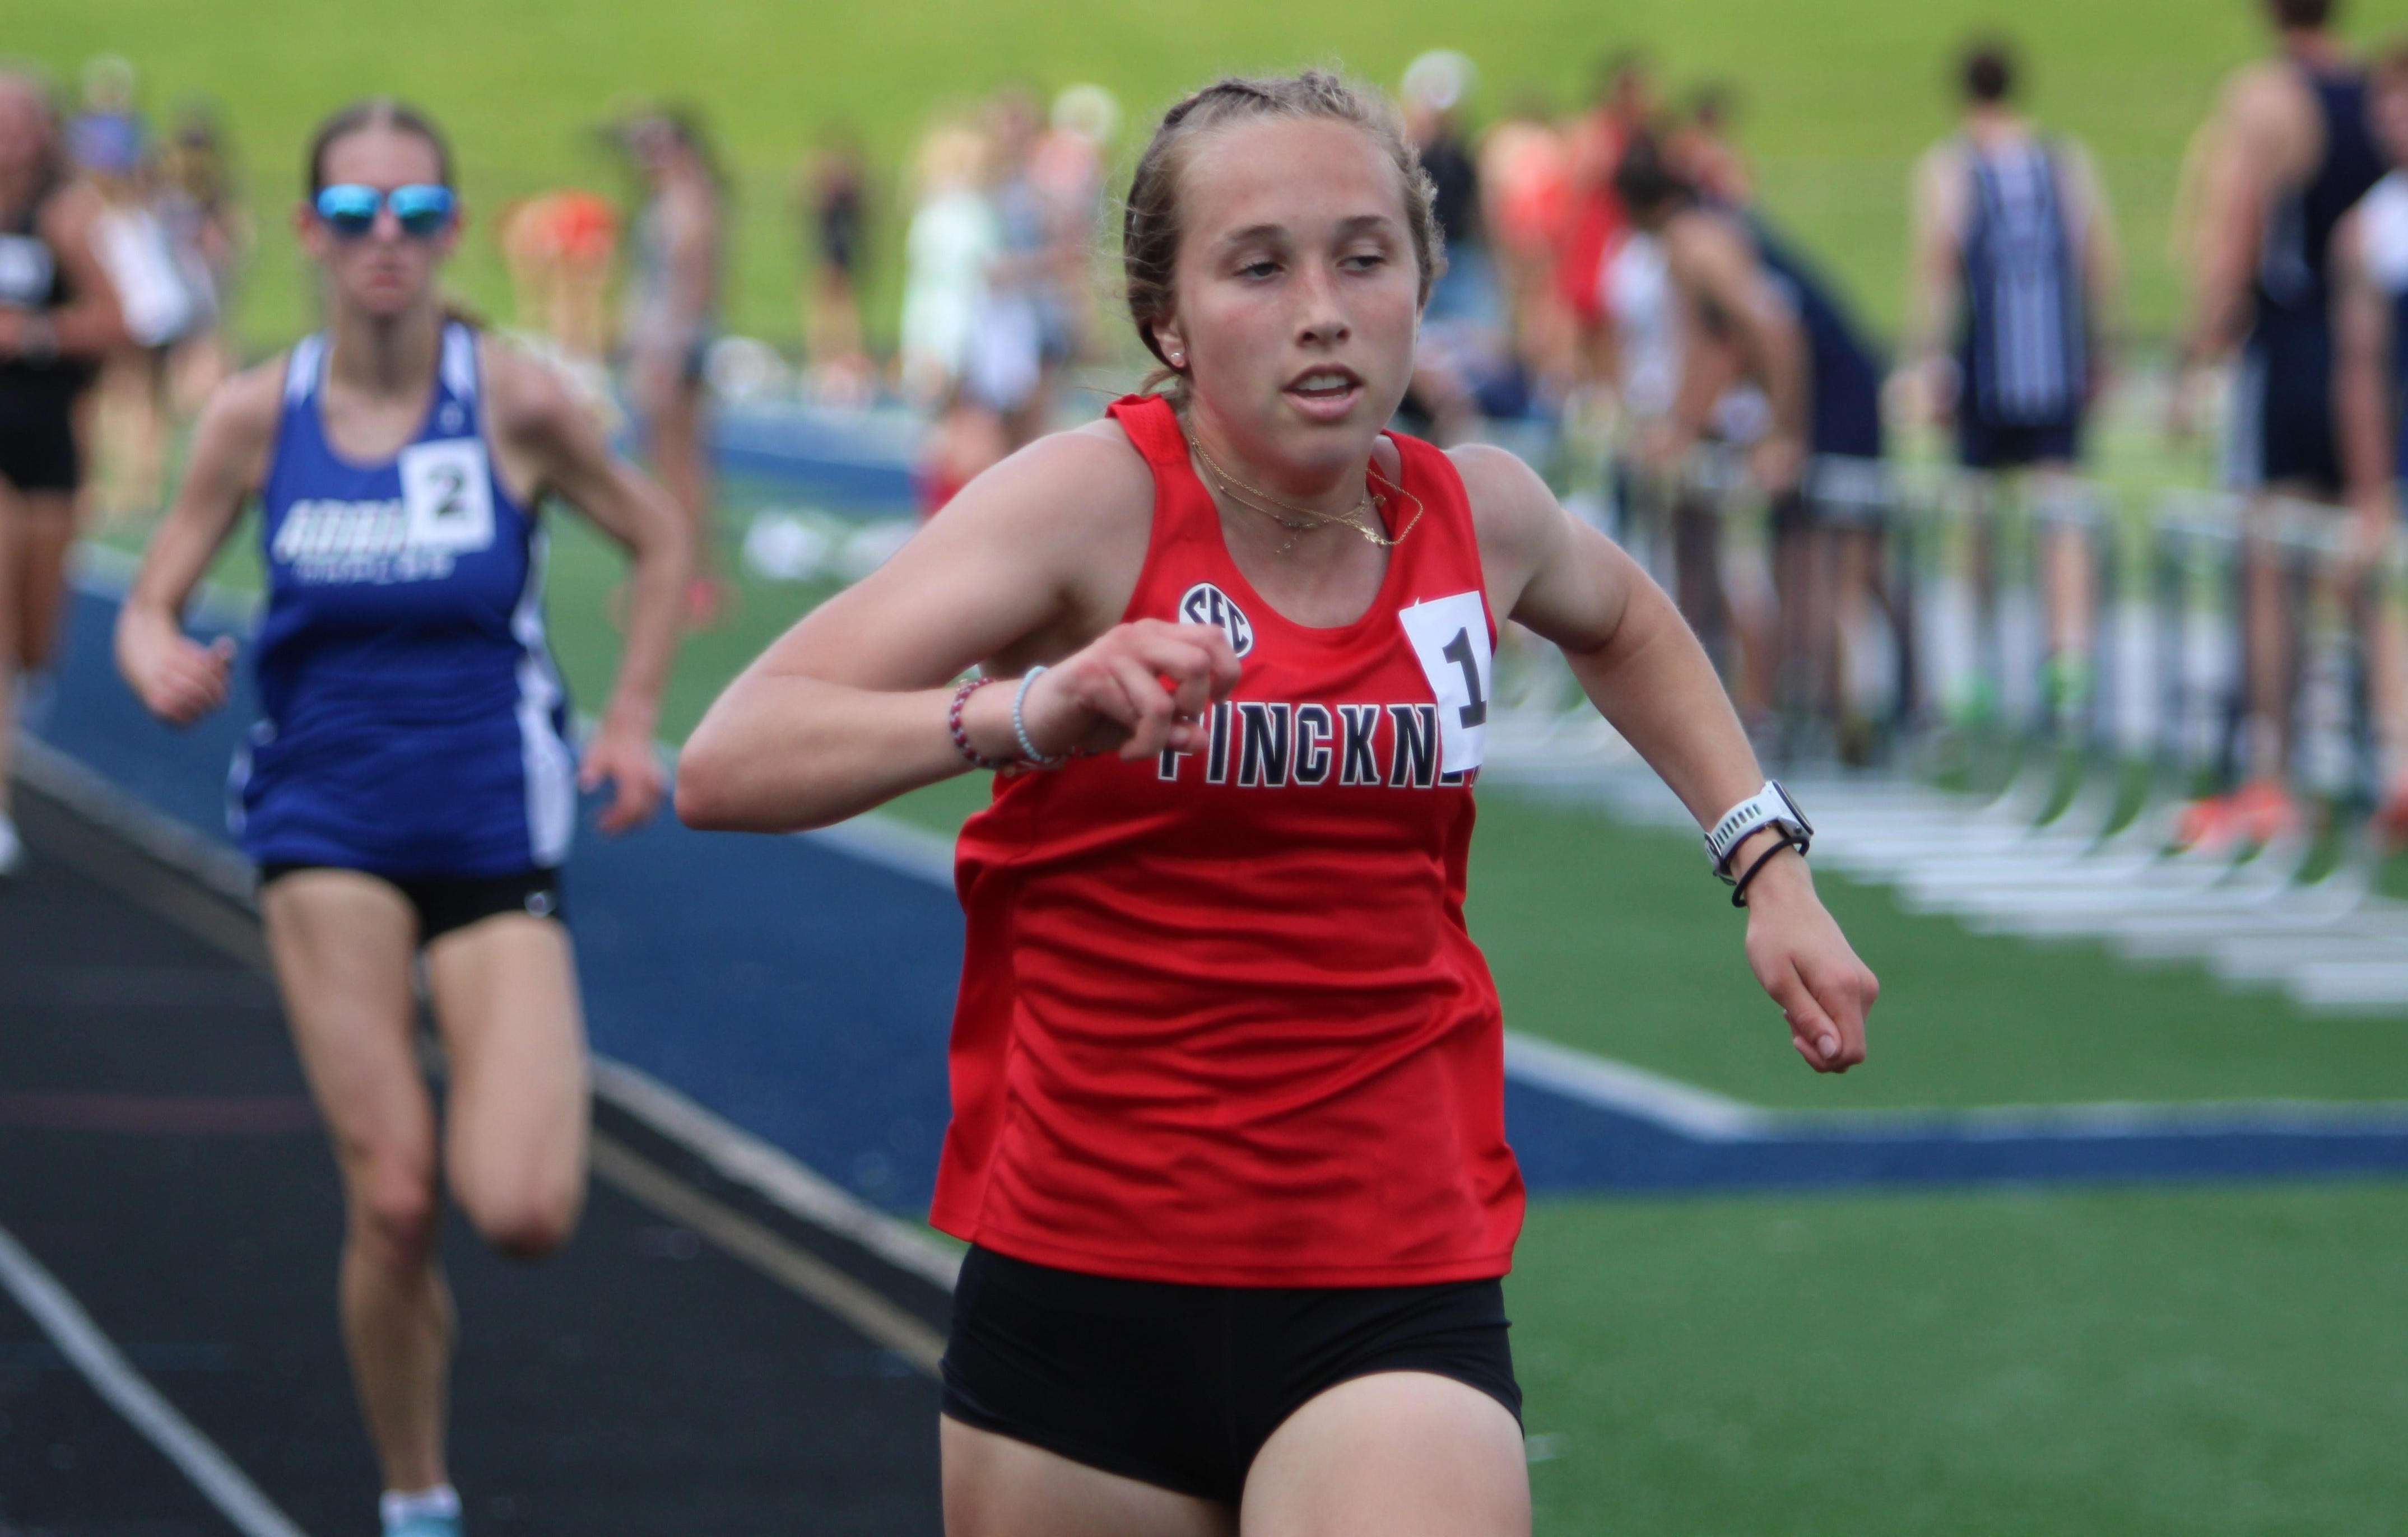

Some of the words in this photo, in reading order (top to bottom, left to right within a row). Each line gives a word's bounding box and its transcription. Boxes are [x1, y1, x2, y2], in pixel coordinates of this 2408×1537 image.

[428, 464, 466, 519] 2
[1442, 626, 1487, 729] 1
[1157, 701, 1482, 788] INCKN
